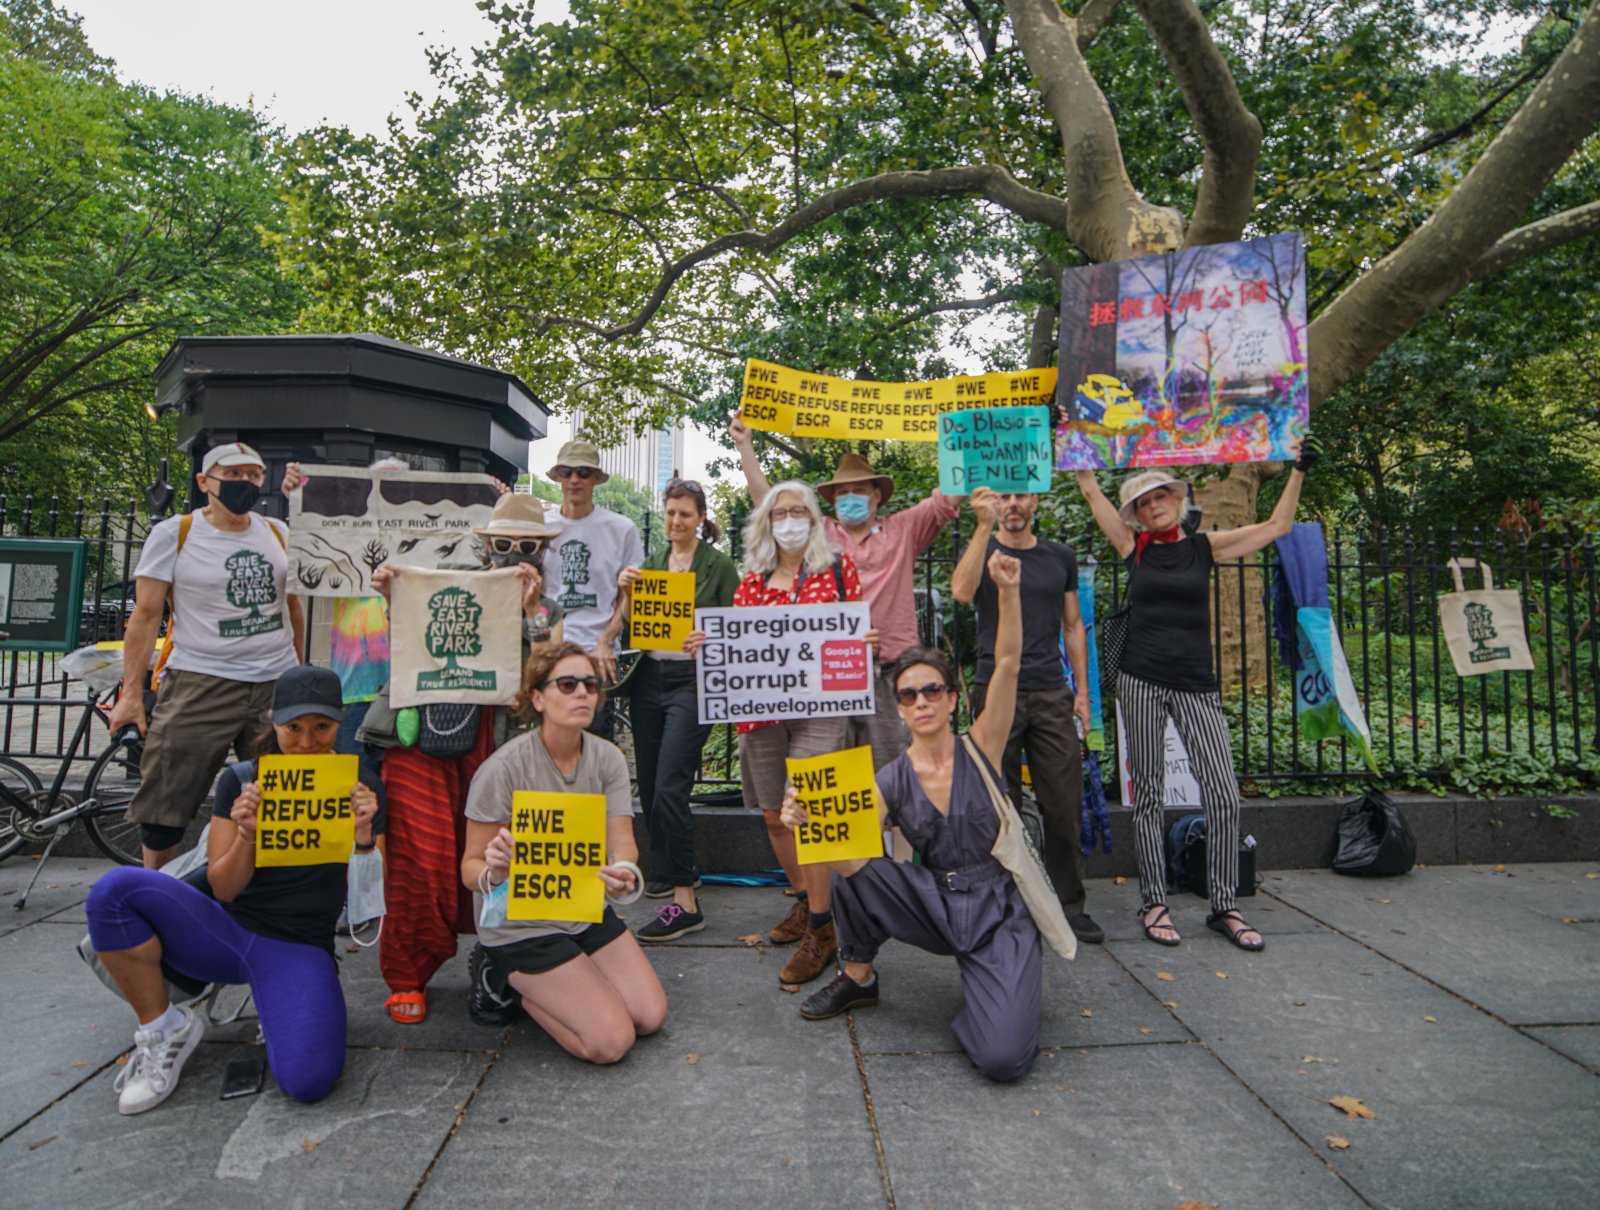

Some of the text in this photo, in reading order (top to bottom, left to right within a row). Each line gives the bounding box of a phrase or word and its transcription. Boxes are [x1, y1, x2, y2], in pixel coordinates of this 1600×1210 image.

[749, 367, 778, 384] #WE
[1011, 376, 1039, 391] #WE
[746, 385, 796, 405] REFUSE
[800, 380, 829, 394] #WE
[852, 387, 880, 399] #WE
[904, 387, 933, 400] #WE
[956, 381, 986, 396] #WE
[743, 403, 776, 421] ESCR
[798, 396, 848, 412] REFUSE
[851, 402, 901, 415] REFUSE
[903, 402, 953, 416] REFUSE
[796, 412, 830, 427] ESCR
[849, 418, 883, 430] ESCR
[903, 420, 937, 432] ESCR
[942, 417, 968, 435] De
[973, 411, 1025, 433] Blasio
[944, 433, 997, 451] Global
[980, 441, 1048, 463] WARMING
[952, 464, 1040, 486] DENIER
[322, 518, 347, 528] DON'T
[377, 519, 403, 528] EAST
[408, 519, 438, 528] RIVER
[445, 519, 471, 528] PARK
[227, 554, 260, 570] SAVE
[564, 552, 588, 562] EAST
[236, 564, 270, 579] EAST
[562, 570, 587, 582] PARK
[231, 577, 271, 592] RIVER
[634, 579, 668, 595] #WE
[234, 588, 273, 605] PARK
[431, 593, 468, 609] SAVE
[437, 607, 478, 622] EAST
[633, 600, 692, 618] REFUSE
[430, 621, 475, 637] RIVER
[633, 621, 671, 639] ESCR
[702, 612, 860, 640] Egregiously
[431, 636, 476, 654] PARK
[825, 647, 862, 657] Google
[703, 642, 815, 667] Shady &
[420, 680, 445, 688] TRUE
[704, 669, 808, 694] Corrupt
[705, 695, 872, 721] Redevelopment
[263, 769, 315, 791] #WE
[792, 766, 837, 793] #WE
[261, 797, 351, 822] REFUSE
[516, 808, 564, 833] #WE
[261, 829, 321, 850] ESCR
[799, 822, 850, 844] ESCR
[514, 842, 601, 866] REFUSE
[513, 874, 572, 899] ESCR
